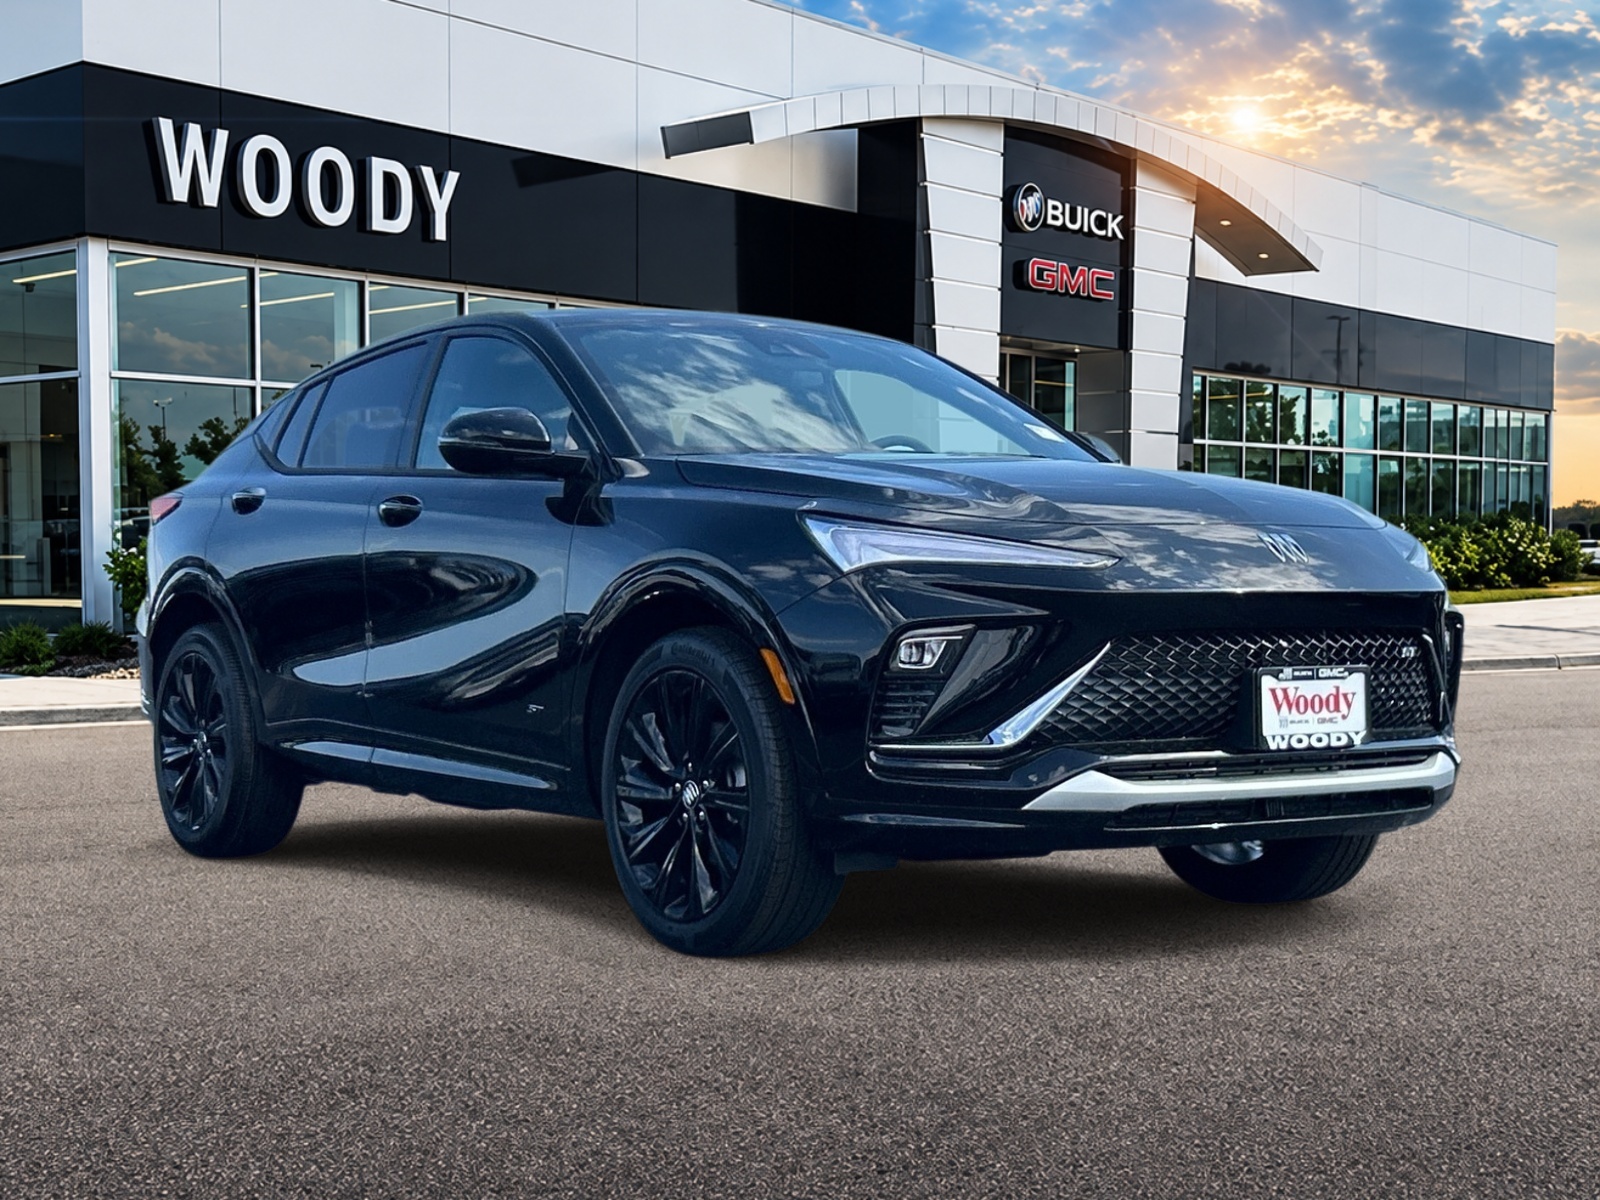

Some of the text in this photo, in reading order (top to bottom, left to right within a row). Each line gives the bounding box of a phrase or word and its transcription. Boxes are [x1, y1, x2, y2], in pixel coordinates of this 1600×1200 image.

[152, 116, 461, 242] WOODY
[1046, 199, 1124, 240] BUICK
[1029, 258, 1114, 300] GMC
[1268, 685, 1356, 721] Woody
[1265, 731, 1367, 750] WOODY
